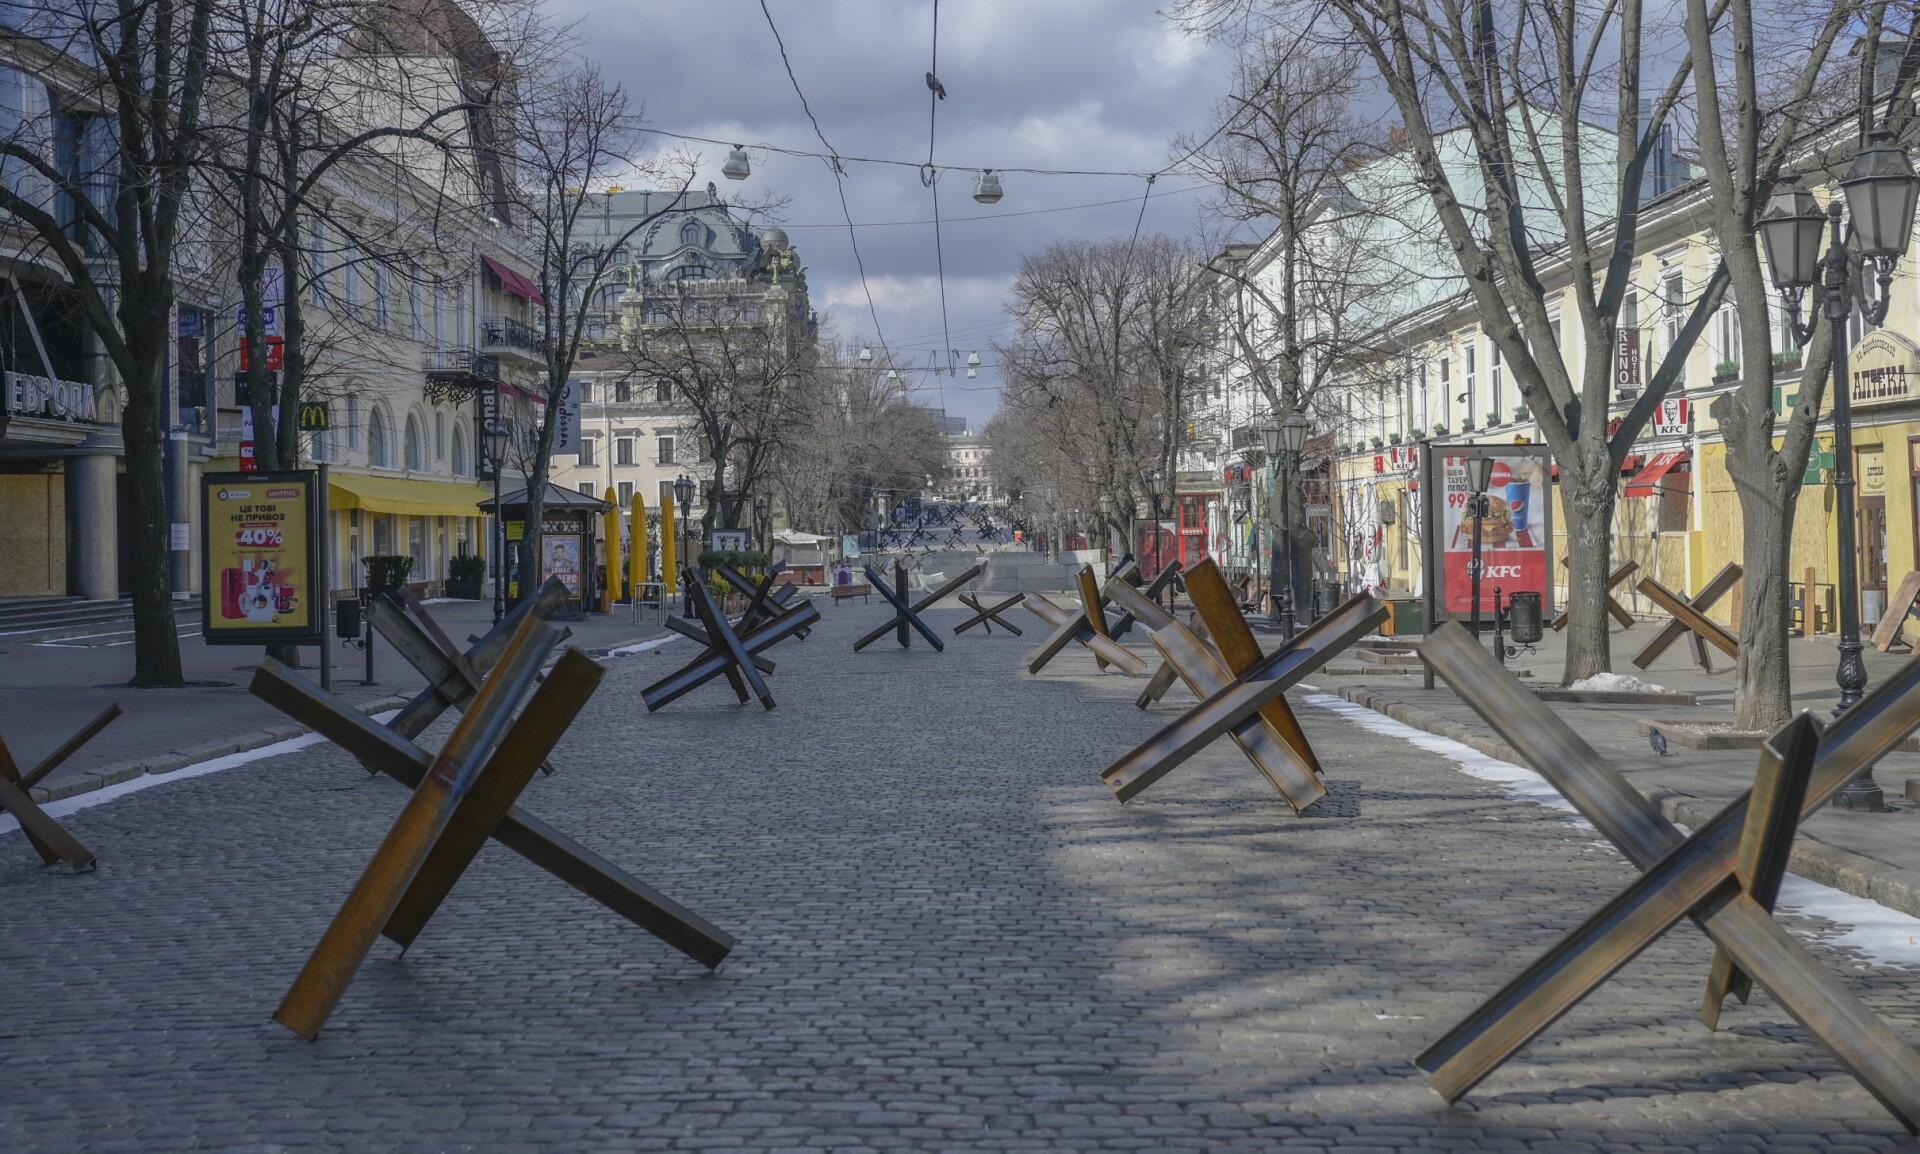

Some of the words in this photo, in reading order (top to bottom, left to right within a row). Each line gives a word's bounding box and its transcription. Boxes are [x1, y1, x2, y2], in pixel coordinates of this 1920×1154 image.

[1618, 329, 1629, 384] RENO
[1853, 365, 1907, 400] АПТЕКА
[1661, 425, 1683, 433] KFC
[1448, 494, 1465, 508] 99
[240, 505, 252, 513] ЦЕ
[231, 514, 244, 522] НЕ
[246, 513, 284, 521] ПРИВОЗ
[240, 529, 283, 545] 40%
[1486, 566, 1521, 578] KFC
